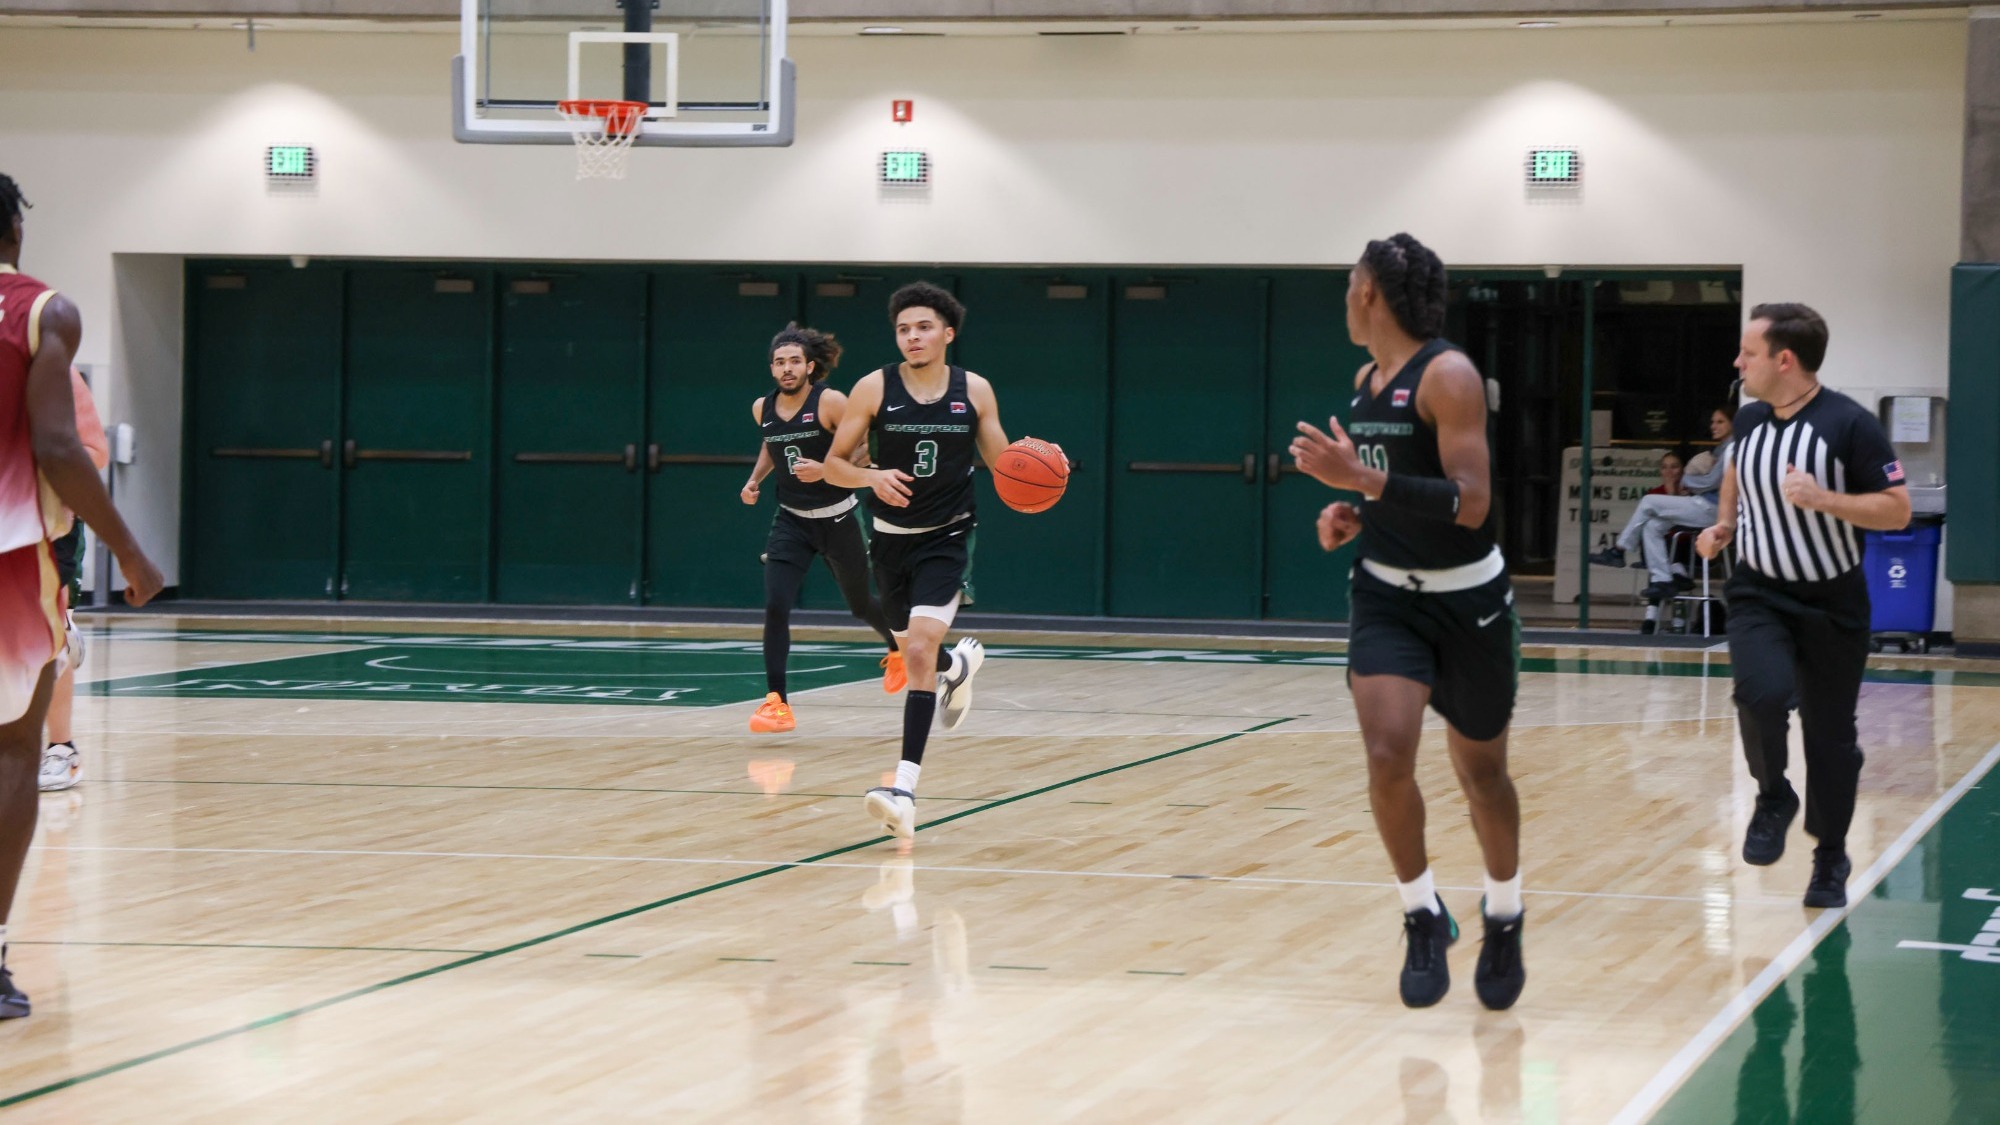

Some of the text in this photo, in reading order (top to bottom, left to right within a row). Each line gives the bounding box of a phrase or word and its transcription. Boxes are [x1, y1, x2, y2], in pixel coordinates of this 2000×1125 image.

[273, 148, 305, 173] EXIT
[886, 153, 920, 179] EXIT
[1535, 152, 1571, 178] EXIT
[885, 424, 969, 434] evergreen
[784, 446, 803, 475] 2
[913, 440, 938, 477] 3
[1569, 485, 1612, 500] MNS
[1569, 508, 1609, 523] TUR
